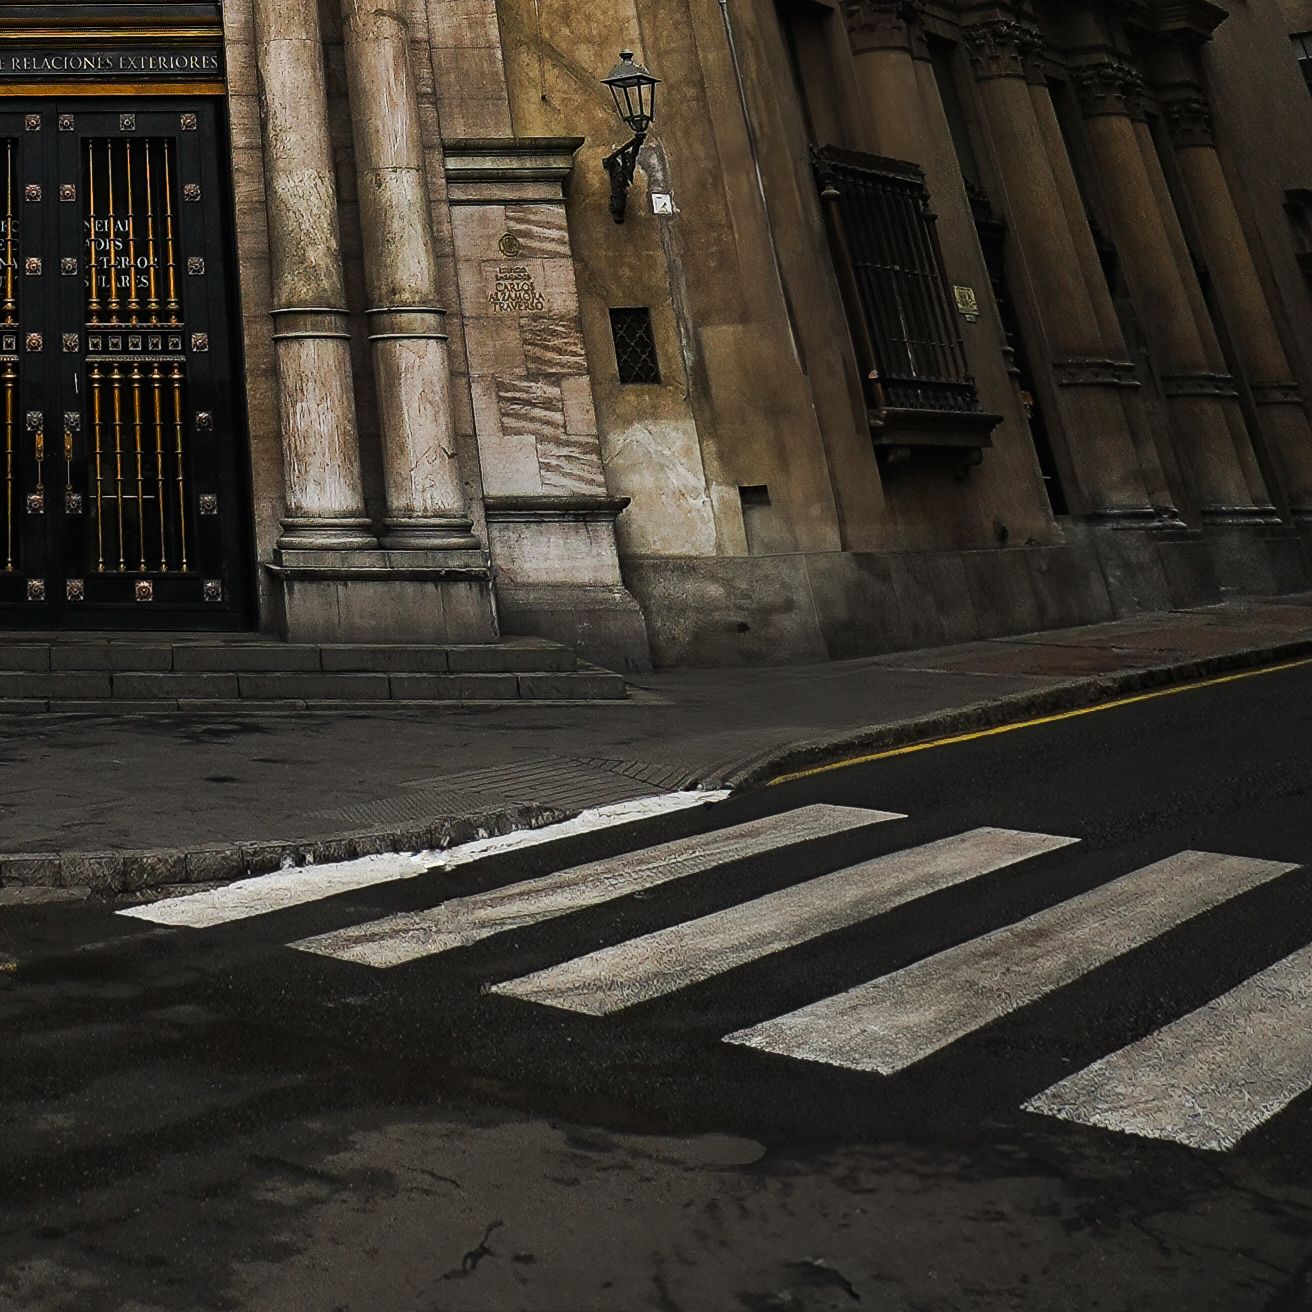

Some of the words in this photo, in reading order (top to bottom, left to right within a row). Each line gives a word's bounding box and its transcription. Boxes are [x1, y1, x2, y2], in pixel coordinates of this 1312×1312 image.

[11, 56, 113, 70] RELACIONES
[119, 55, 219, 69] EXTERIORES
[495, 281, 535, 292] CARLOS
[488, 290, 545, 302] ALZAMORA
[490, 301, 545, 312] TRAVERSO
